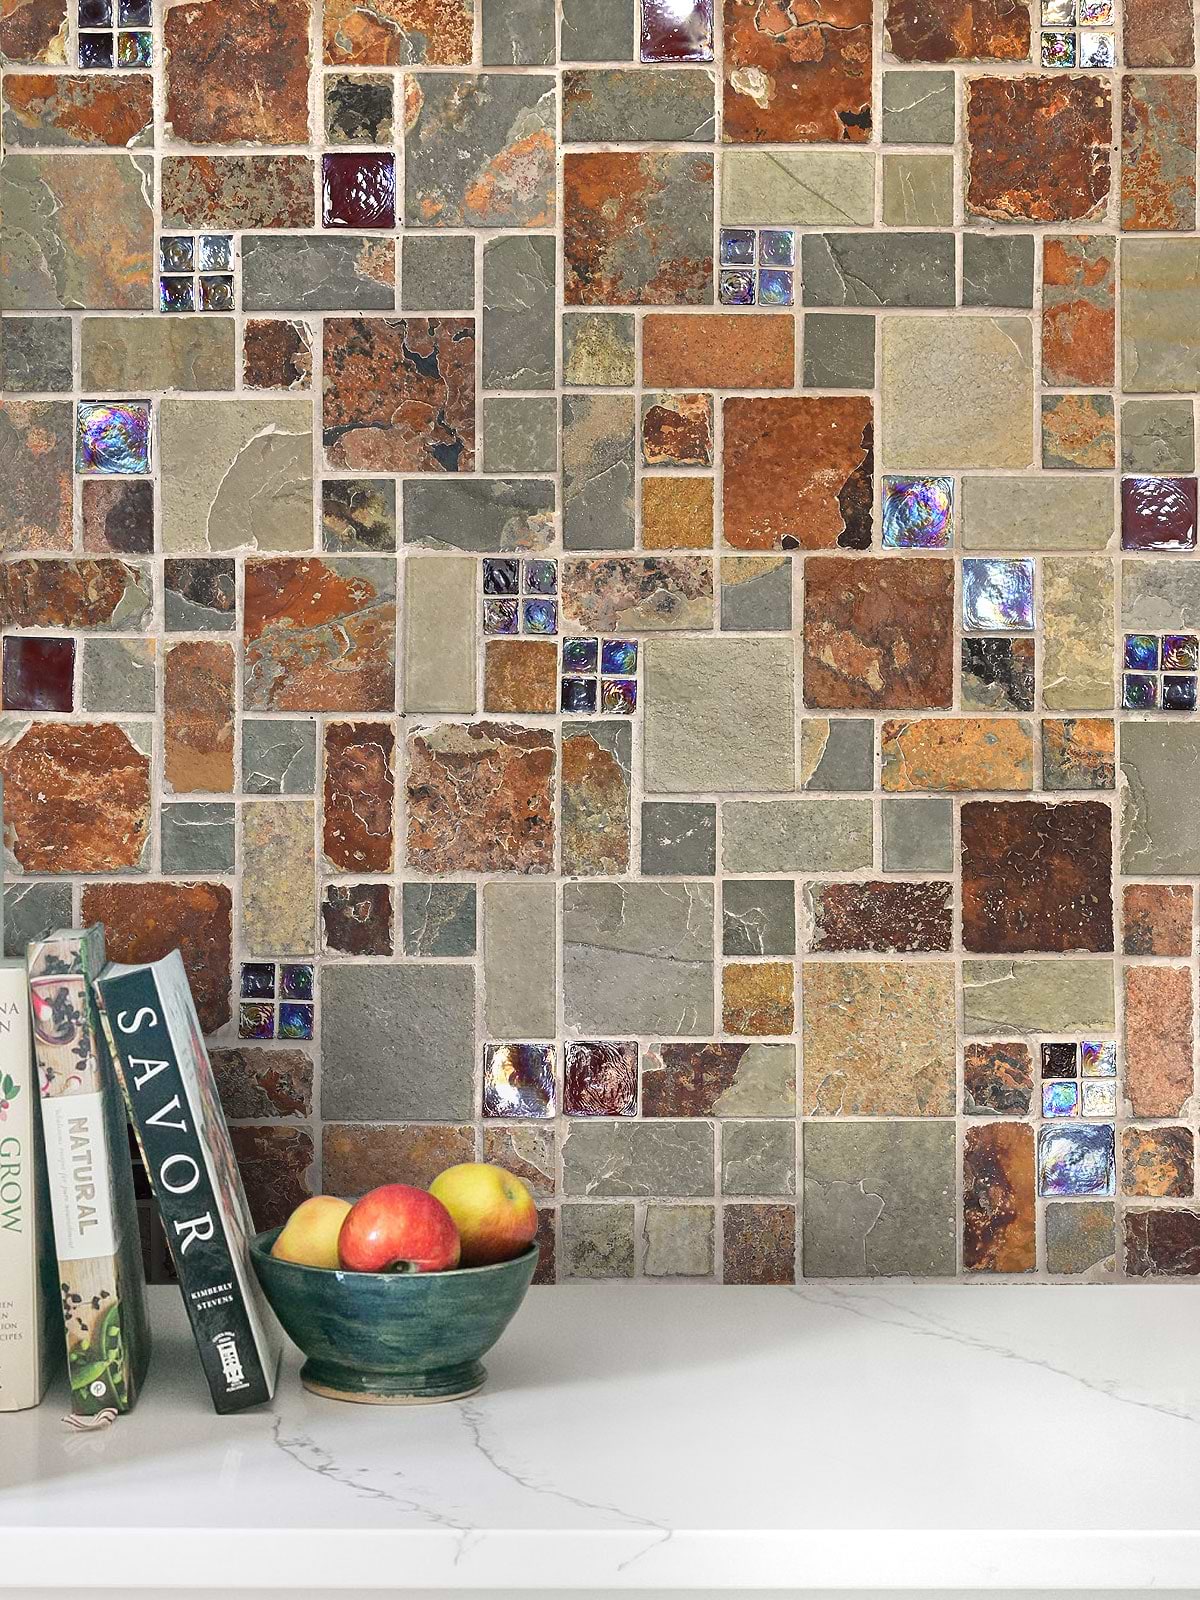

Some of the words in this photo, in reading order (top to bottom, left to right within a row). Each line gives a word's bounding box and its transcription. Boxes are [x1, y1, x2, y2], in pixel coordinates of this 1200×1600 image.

[68, 1117, 98, 1236] NATURAL
[117, 1006, 214, 1255] SAVOR
[0, 1137, 22, 1233] GROW
[191, 1282, 233, 1299] KIMBERLY
[196, 1295, 234, 1311] STEVENS
